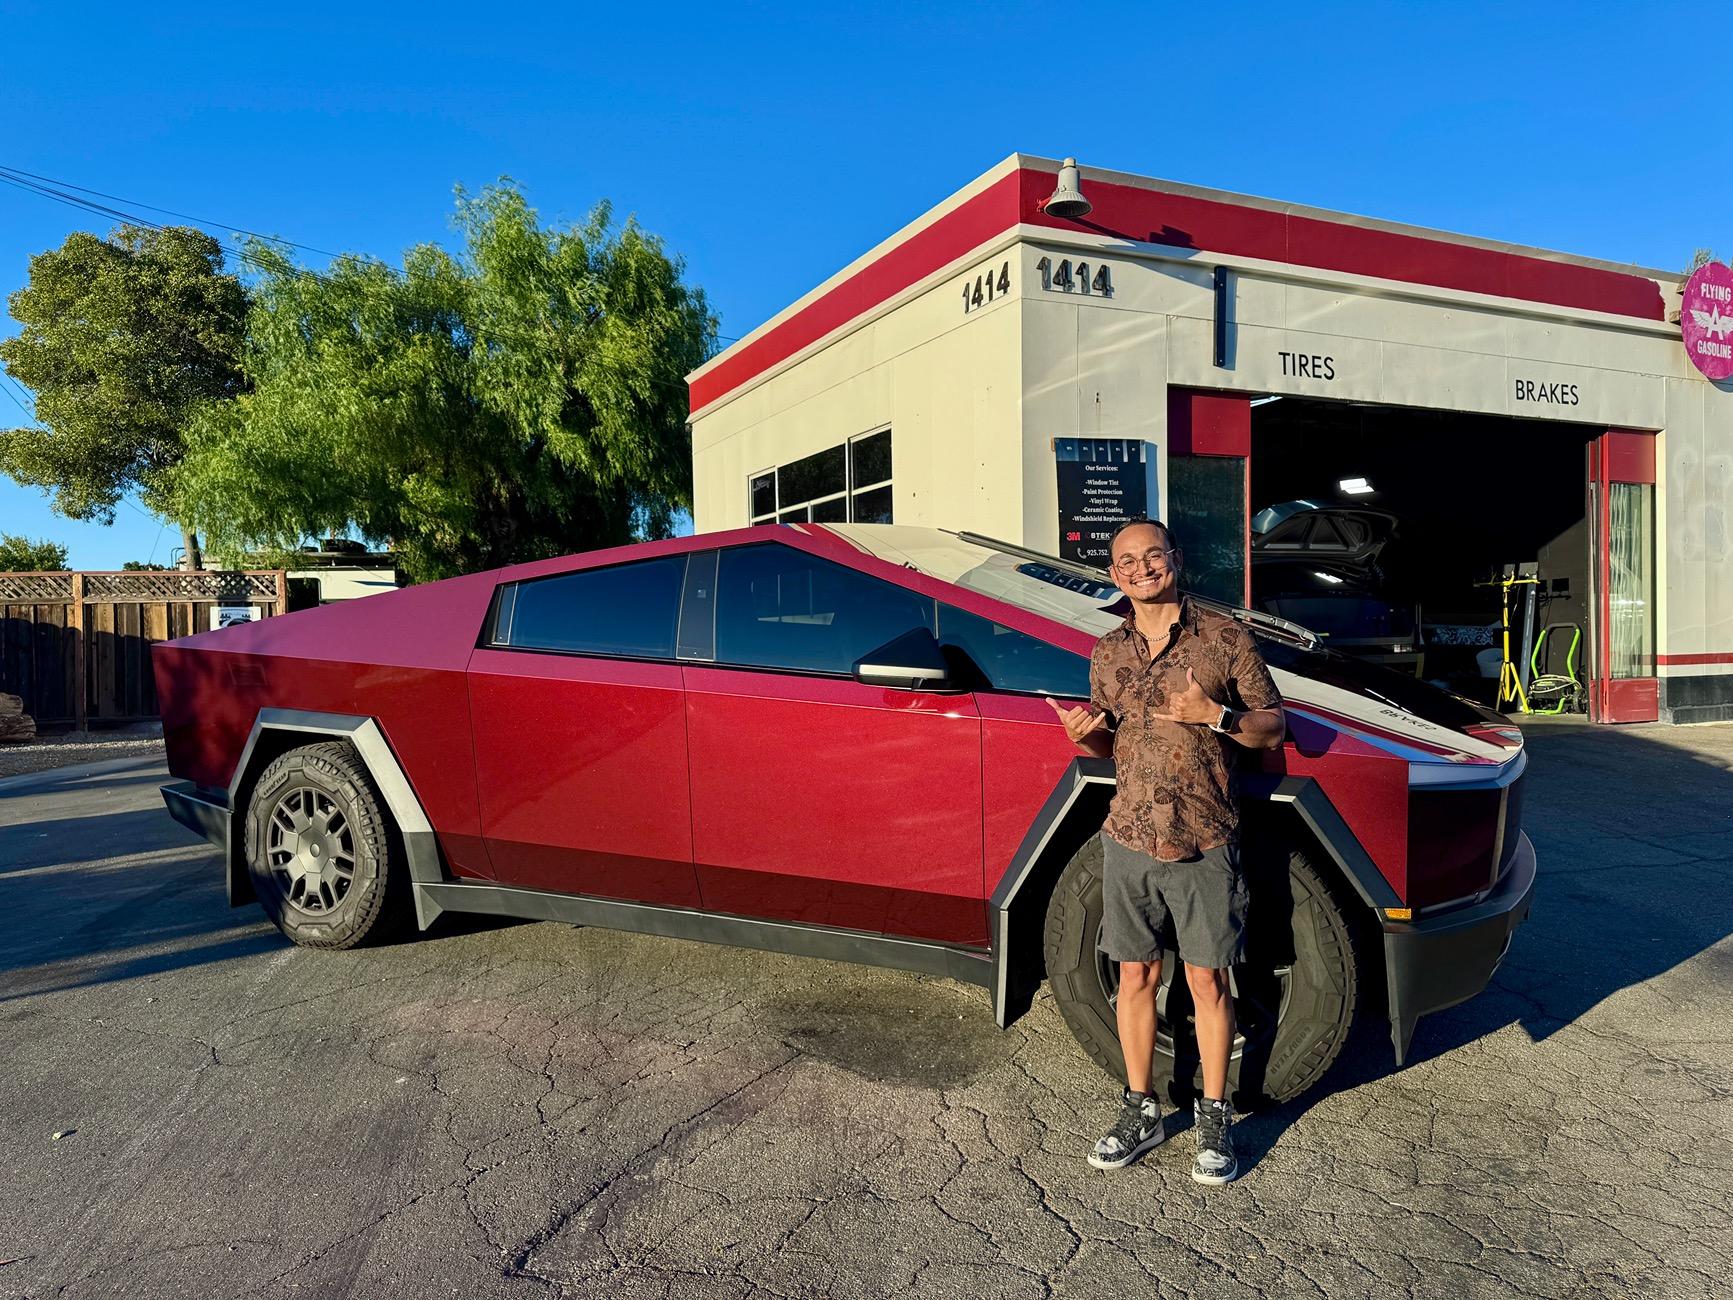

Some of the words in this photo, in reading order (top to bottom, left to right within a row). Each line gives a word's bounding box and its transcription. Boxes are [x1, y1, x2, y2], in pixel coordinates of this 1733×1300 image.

[963, 261, 1010, 314] 1414
[1036, 256, 1114, 298] 1414
[1701, 283, 1732, 302] FLYING
[1697, 340, 1732, 360] GASOLINE
[1278, 351, 1336, 381] TIRES
[1515, 379, 1580, 406] BRAKES
[1066, 532, 1081, 541] 3M
